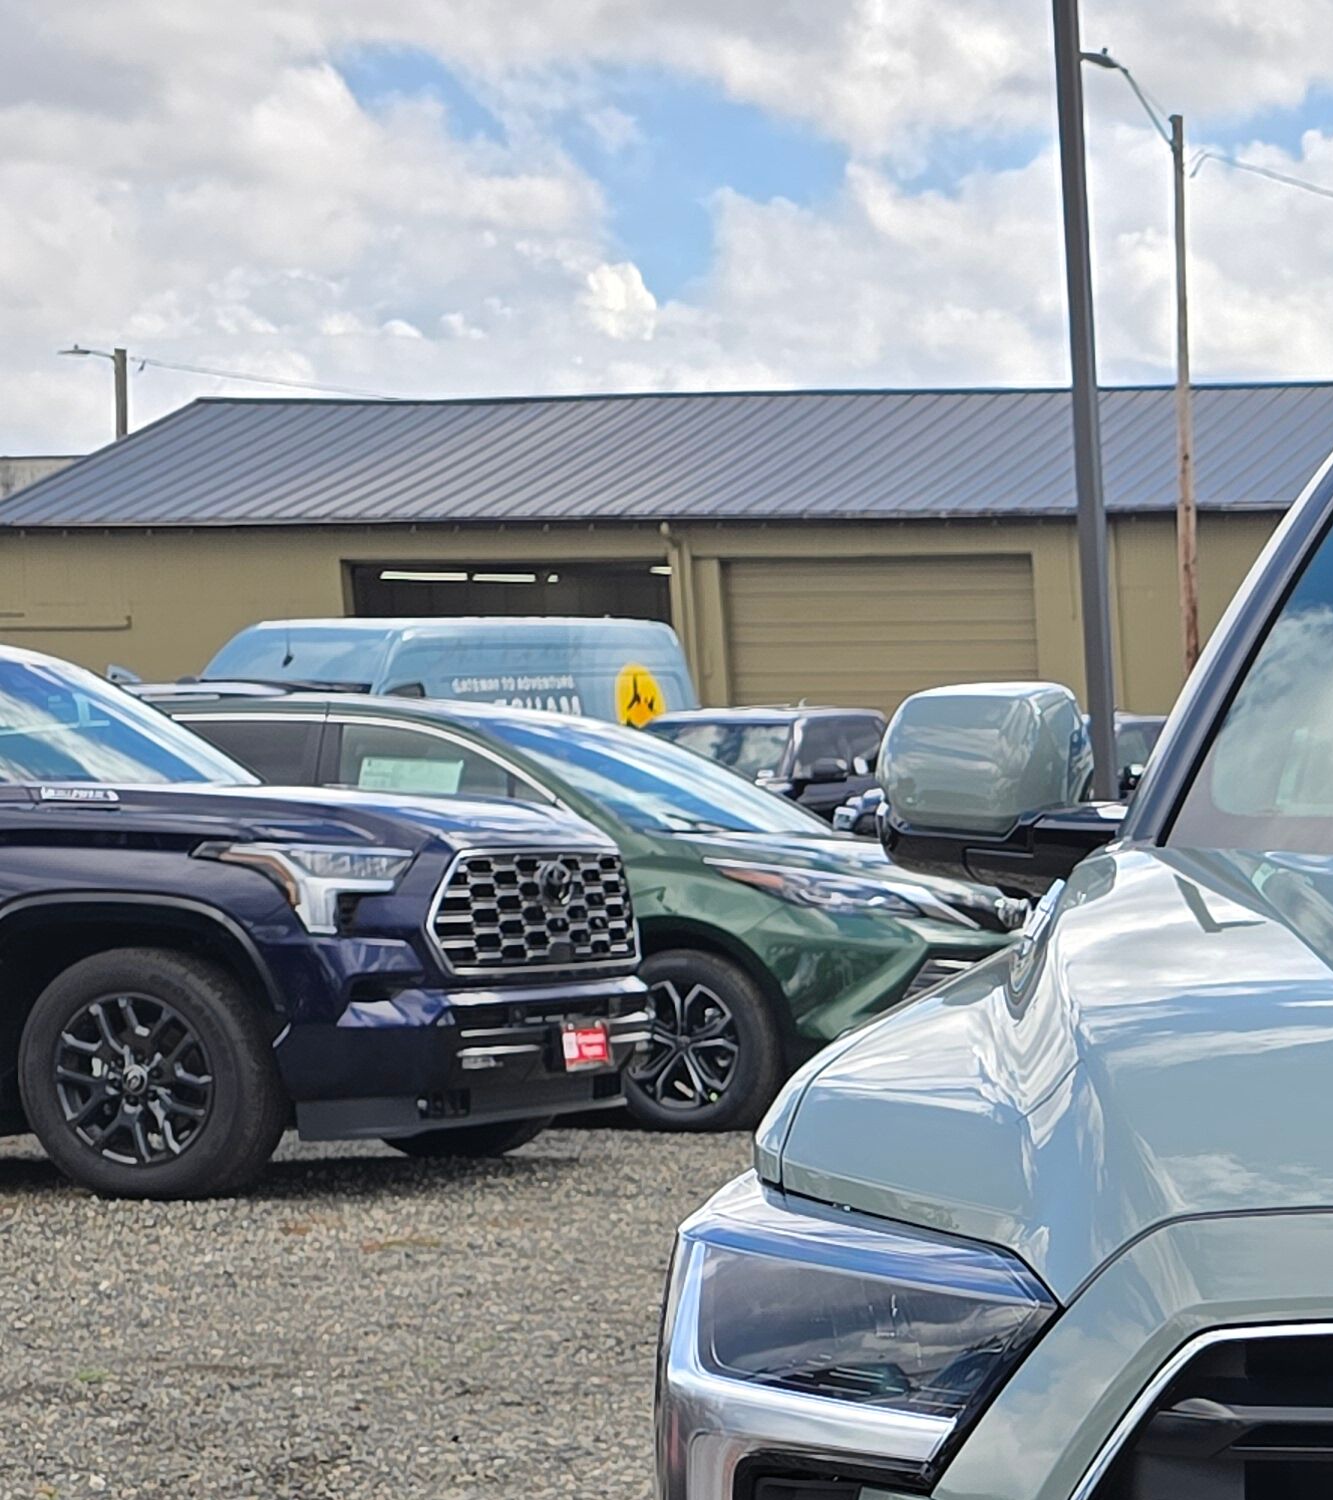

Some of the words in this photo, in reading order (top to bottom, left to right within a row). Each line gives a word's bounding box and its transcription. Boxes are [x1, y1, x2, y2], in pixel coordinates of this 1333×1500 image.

[451, 677, 499, 694] GATEWAY
[501, 676, 515, 691] TO
[517, 674, 575, 690] ADVENTURE
